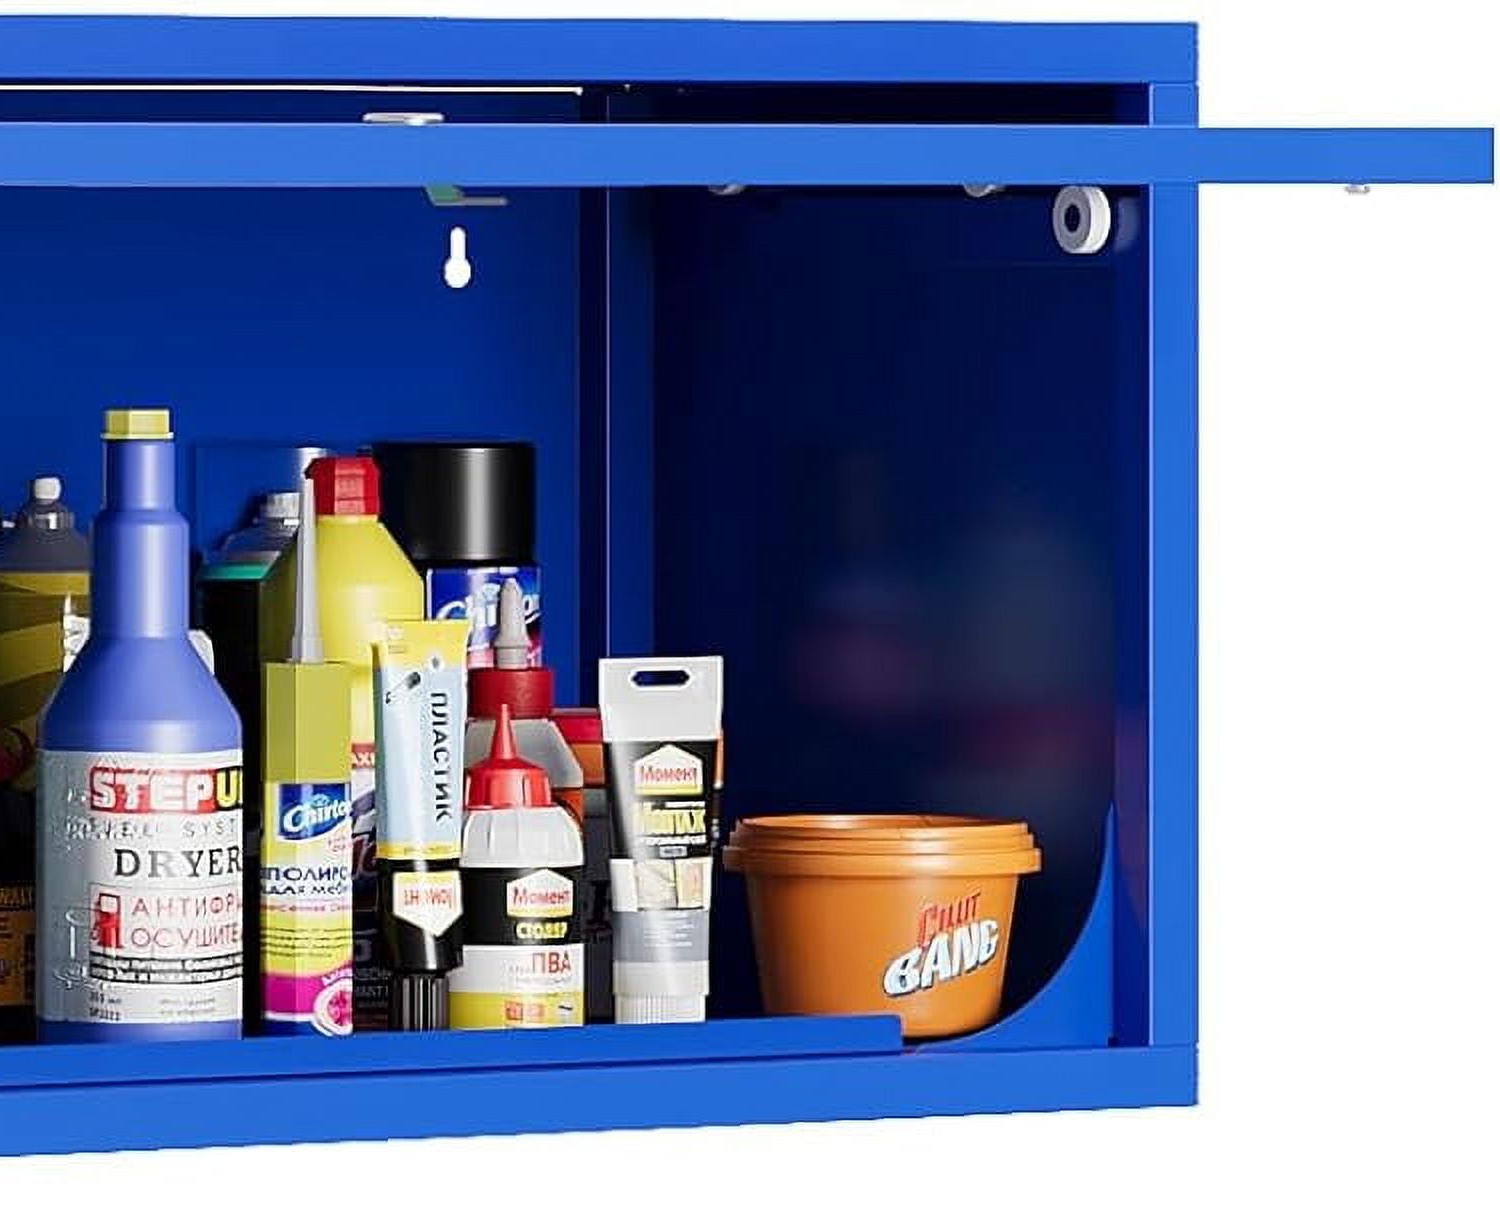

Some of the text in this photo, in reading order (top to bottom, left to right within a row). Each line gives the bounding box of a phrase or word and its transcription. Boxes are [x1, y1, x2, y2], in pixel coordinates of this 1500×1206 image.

[91, 767, 242, 813] STEPU
[114, 845, 242, 878] DRYER
[532, 951, 572, 974] ПВА
[883, 919, 999, 997] BANG
